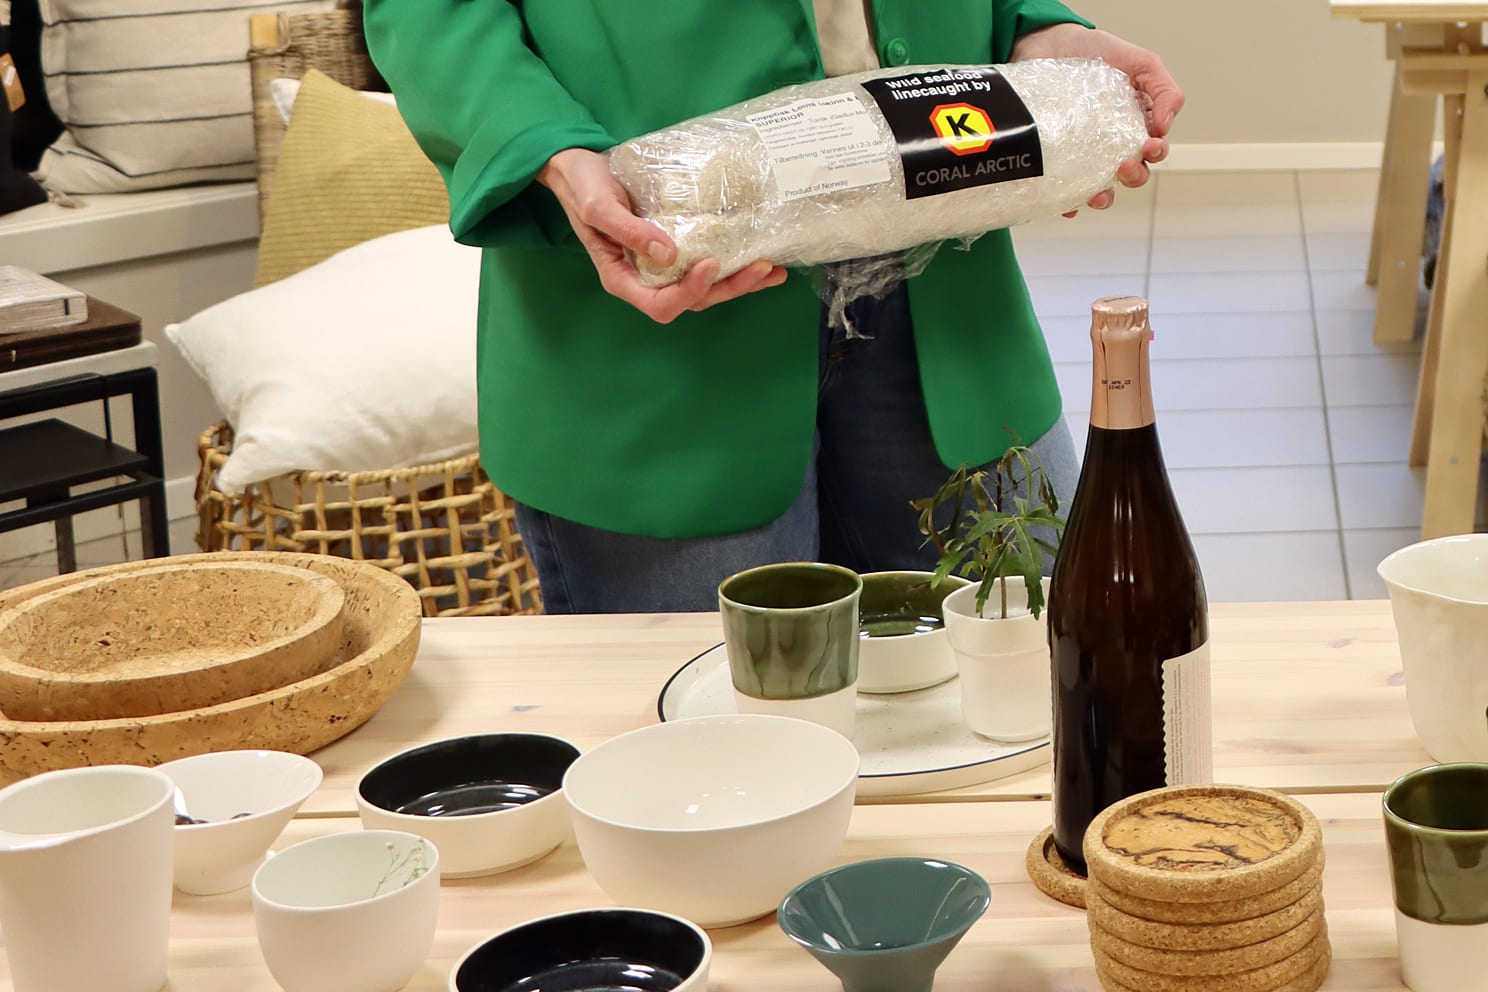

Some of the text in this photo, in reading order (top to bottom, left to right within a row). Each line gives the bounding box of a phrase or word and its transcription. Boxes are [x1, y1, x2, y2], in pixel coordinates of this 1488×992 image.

[886, 68, 984, 90] Wild seafood
[891, 80, 992, 101] linecaught by
[755, 112, 805, 127] SUPERIOR
[946, 112, 981, 142] K
[915, 164, 971, 186] CORAL
[975, 153, 1032, 176] ARCTIC
[784, 180, 849, 198] Product of Norway
